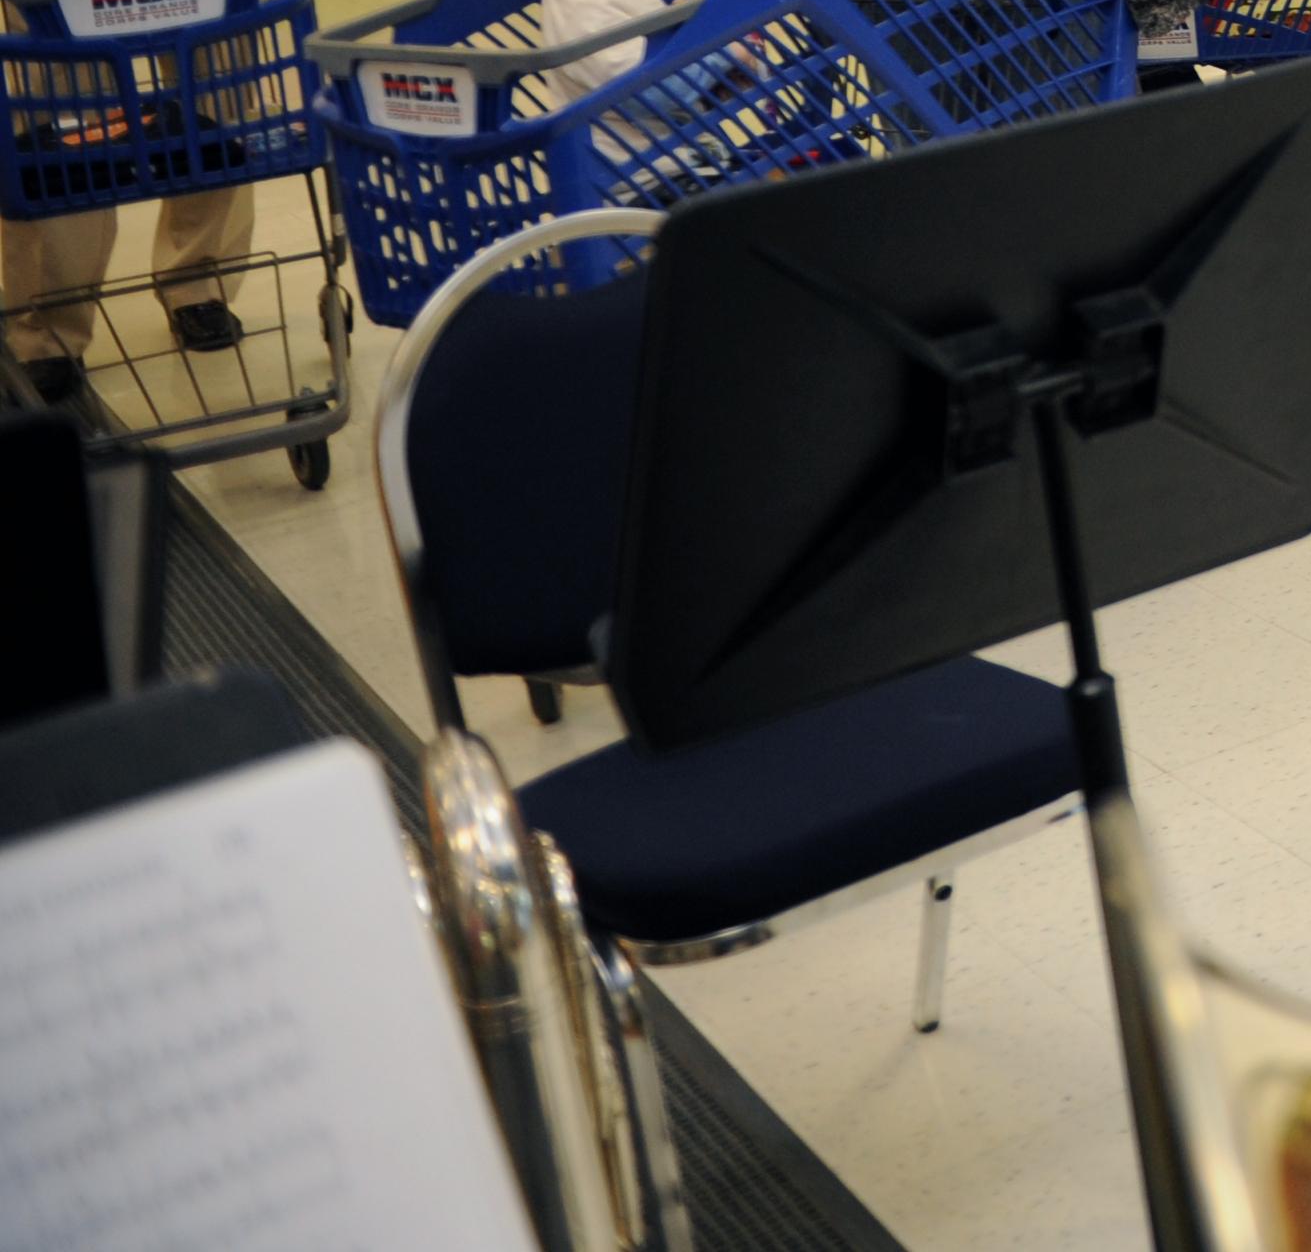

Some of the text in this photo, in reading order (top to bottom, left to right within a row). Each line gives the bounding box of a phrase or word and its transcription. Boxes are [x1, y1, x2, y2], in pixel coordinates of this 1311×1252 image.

[93, 0, 198, 19] CORE BRANDS
[95, 6, 198, 28] CORPS VALUE
[382, 73, 457, 103] MCX
